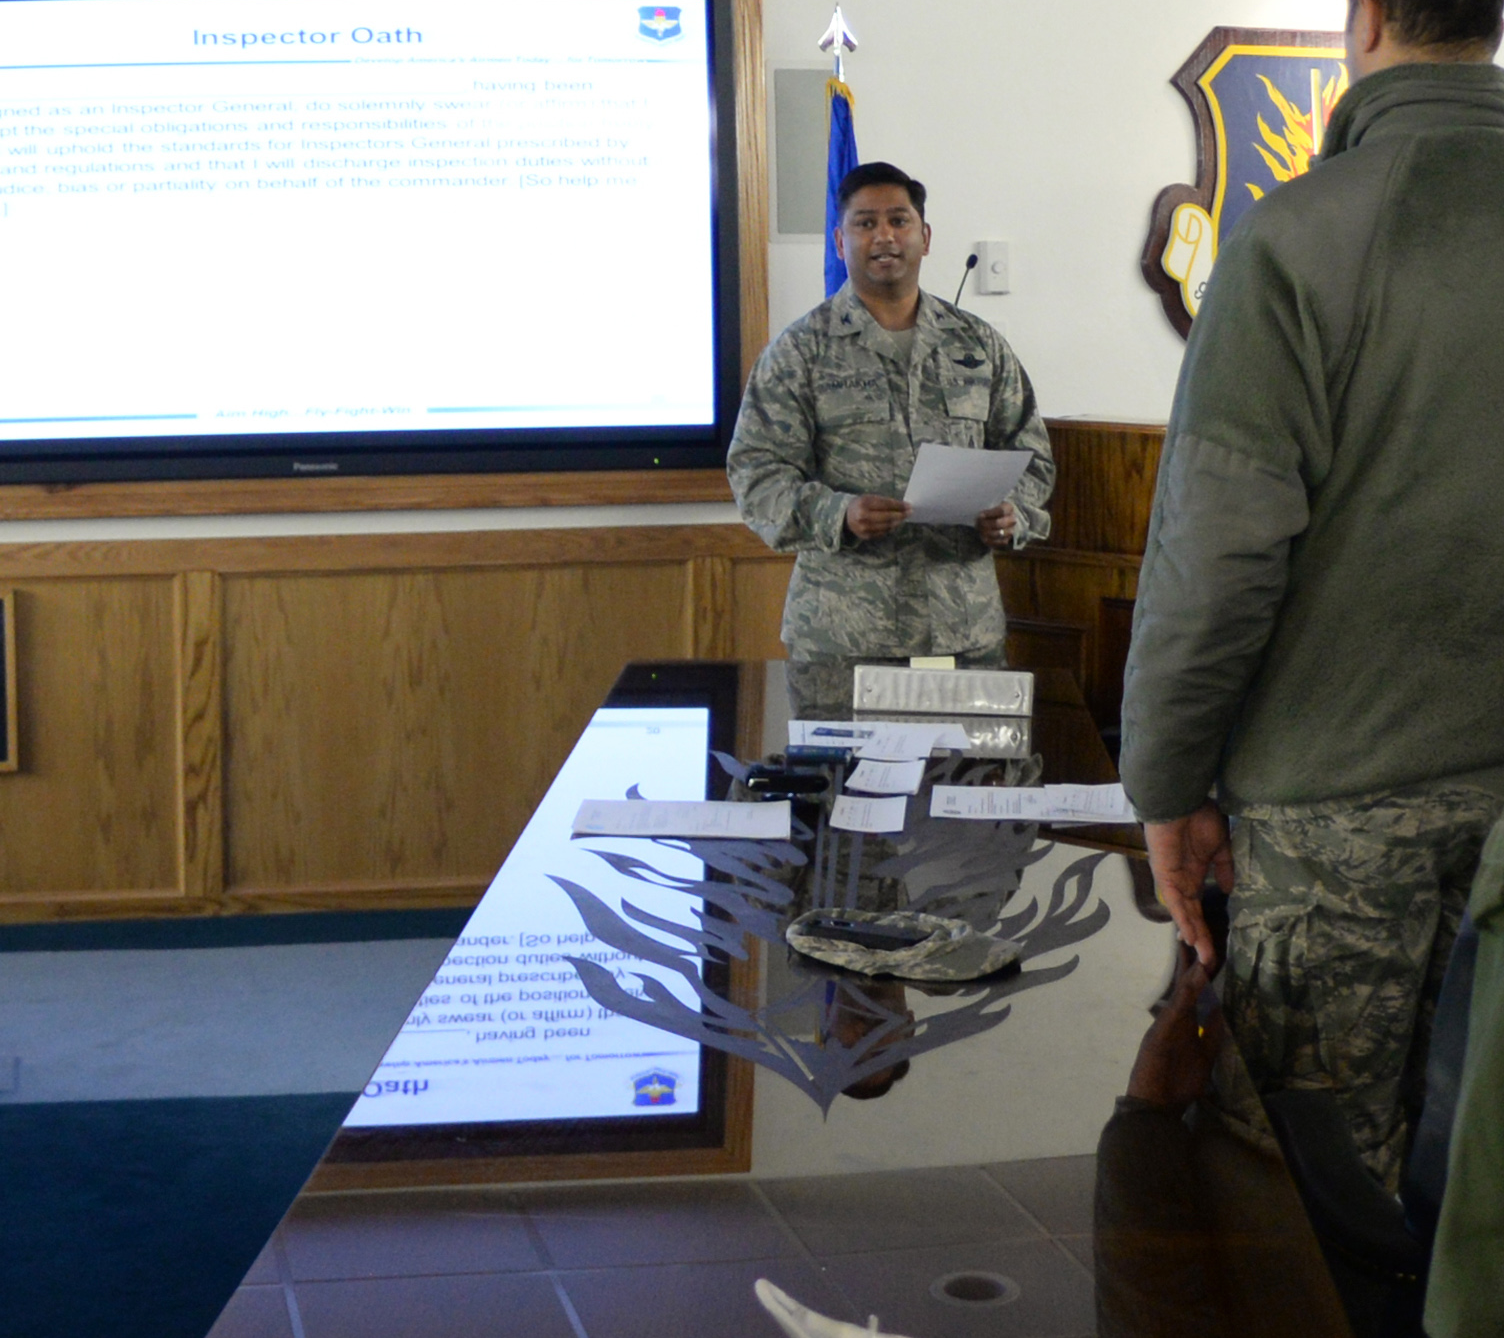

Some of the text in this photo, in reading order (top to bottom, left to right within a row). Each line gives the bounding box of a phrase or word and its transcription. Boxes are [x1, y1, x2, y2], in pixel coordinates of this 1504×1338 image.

[193, 27, 423, 49] Inspector Oath
[473, 77, 594, 95] having been
[49, 106, 71, 116] as
[80, 106, 104, 115] an
[112, 100, 203, 118] Inspector
[306, 98, 330, 111] do
[338, 96, 425, 114] solemnly
[434, 99, 490, 109] swear
[25, 122, 54, 135] the
[64, 120, 133, 138] special
[141, 118, 248, 137] obligations
[258, 118, 293, 131] and
[302, 116, 446, 134] responsibilities
[8, 142, 37, 155] will
[47, 140, 113, 158] uphold
[123, 140, 152, 153] the
[161, 138, 260, 152] standards
[268, 137, 291, 150] for
[302, 136, 404, 154] Inspectors
[412, 135, 490, 148] General
[498, 135, 599, 152] prescribed
[607, 135, 628, 151] by
[1, 162, 36, 175] and
[45, 159, 154, 178] regulations
[164, 158, 200, 171] and
[209, 157, 244, 170] that
[266, 157, 294, 169] will
[304, 155, 400, 173] discharge
[409, 154, 507, 172] inspection
[516, 154, 573, 167] duties
[581, 154, 650, 166] without
[58, 180, 99, 193] bias
[107, 183, 124, 192] or
[133, 177, 216, 196] partiality
[225, 180, 250, 190] on
[257, 176, 317, 189] behalf
[326, 175, 344, 188] of
[351, 175, 380, 188] the
[559, 173, 599, 190] help
[607, 176, 637, 185] me
